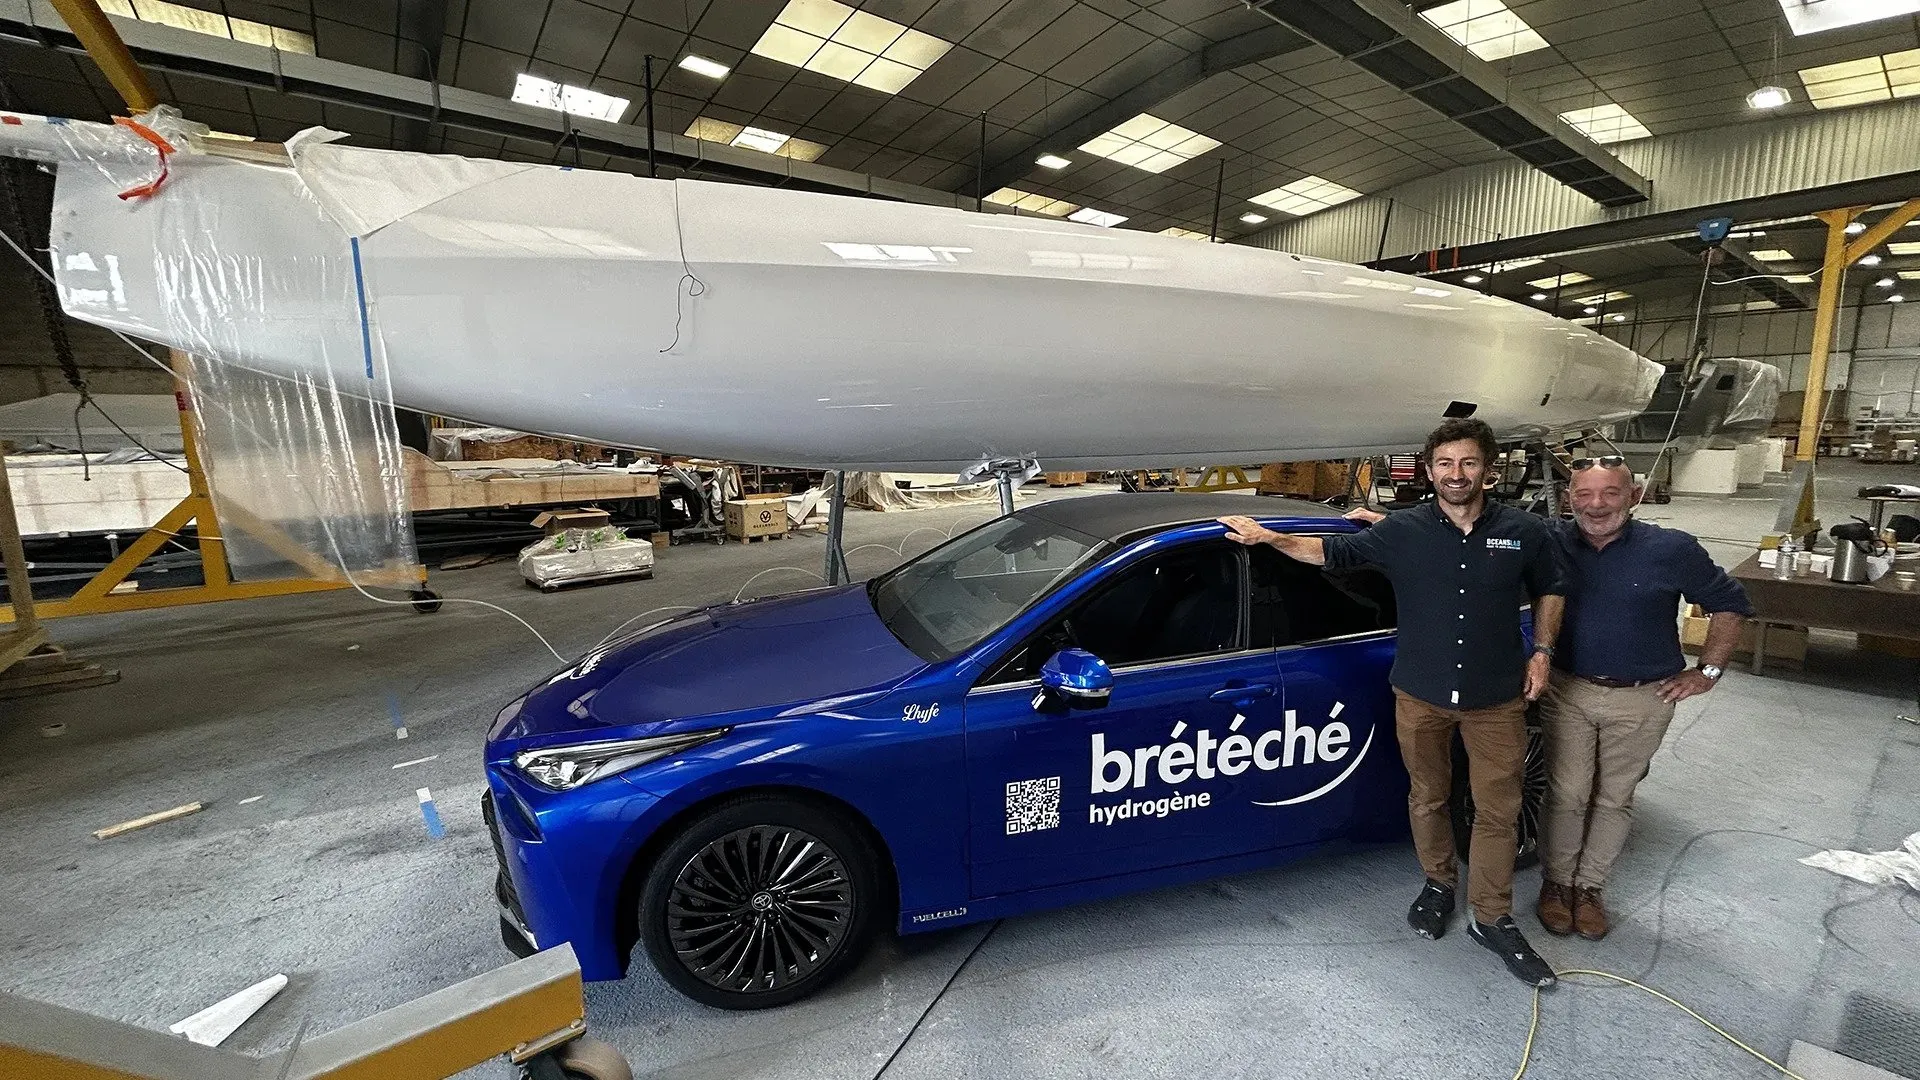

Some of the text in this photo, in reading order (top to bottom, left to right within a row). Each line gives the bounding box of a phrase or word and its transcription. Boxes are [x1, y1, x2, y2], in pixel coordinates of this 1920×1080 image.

[902, 702, 939, 723] Lhyfe
[1091, 701, 1351, 794] brétéché
[1089, 792, 1211, 826] hydrogène
